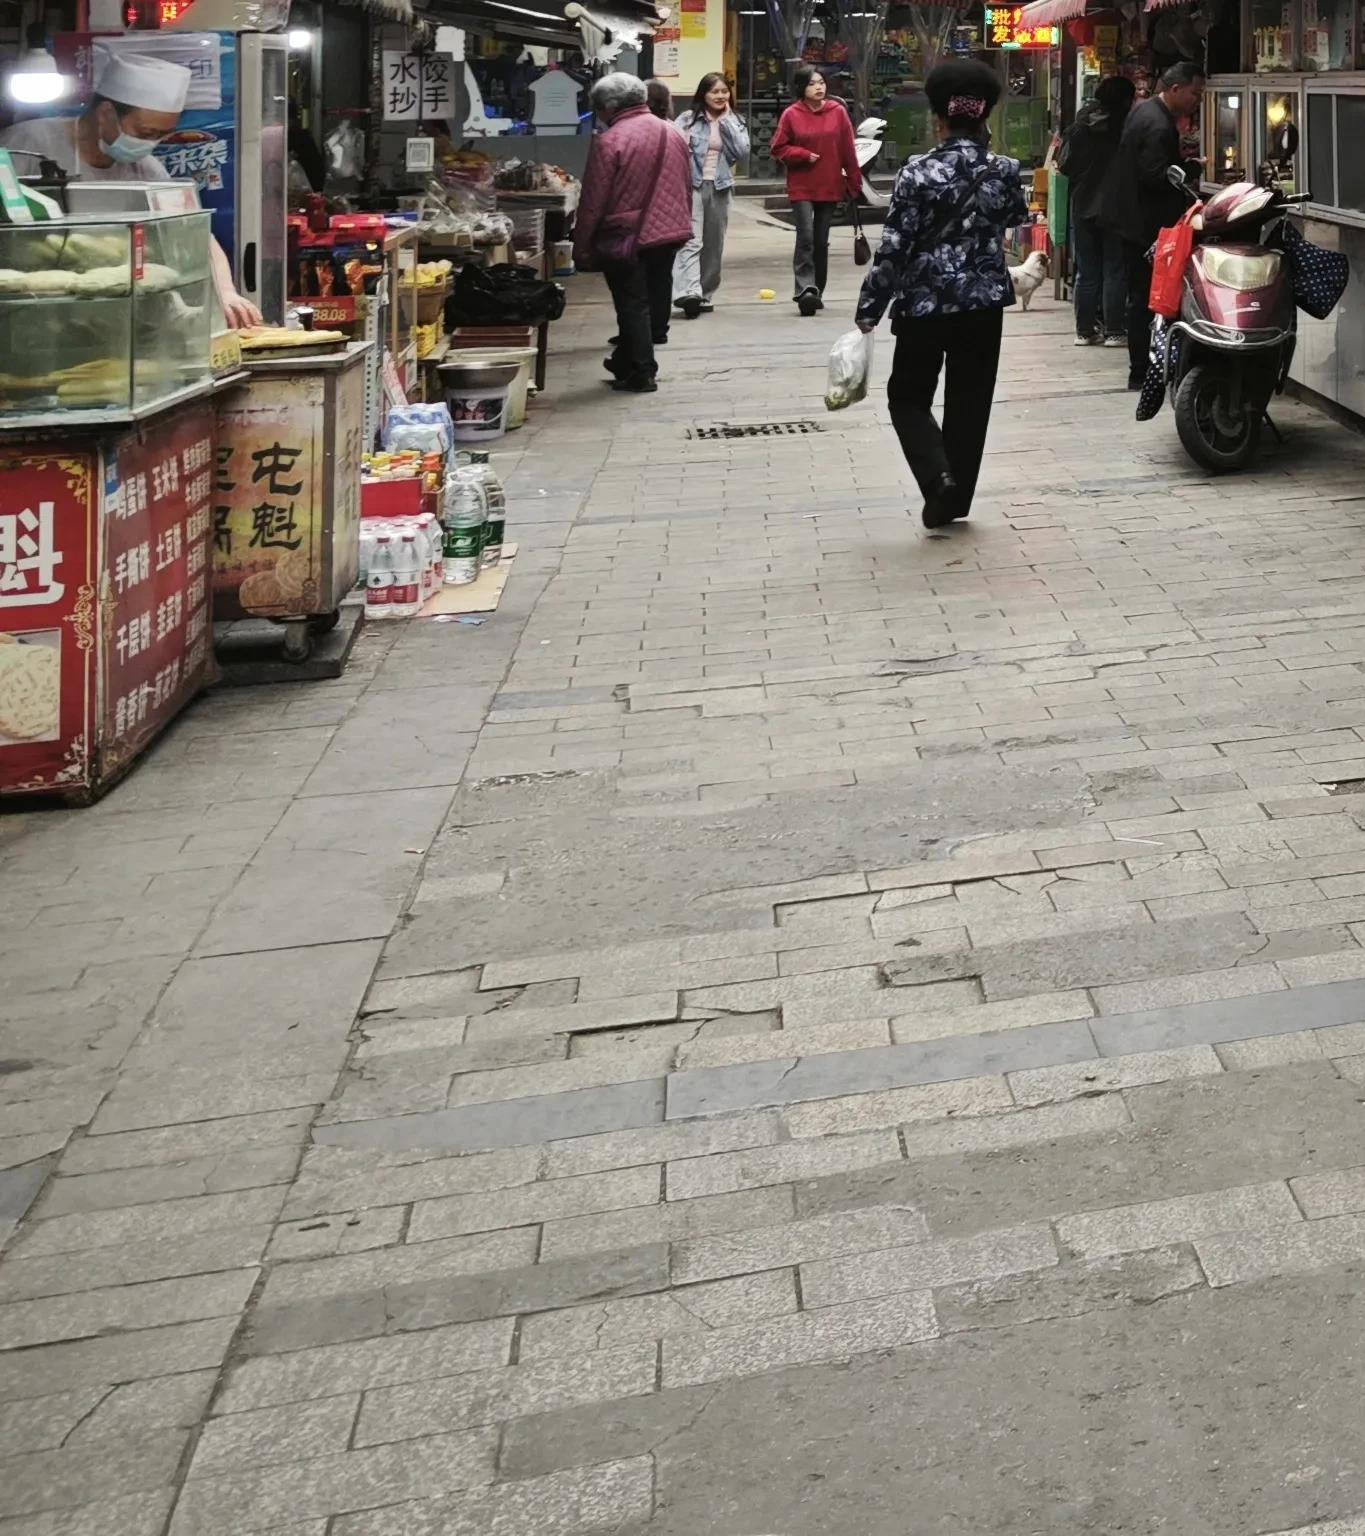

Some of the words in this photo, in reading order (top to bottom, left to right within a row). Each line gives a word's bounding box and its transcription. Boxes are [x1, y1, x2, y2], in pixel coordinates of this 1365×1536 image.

[389, 86, 450, 114] 抄手
[156, 522, 182, 571] 土豆饼
